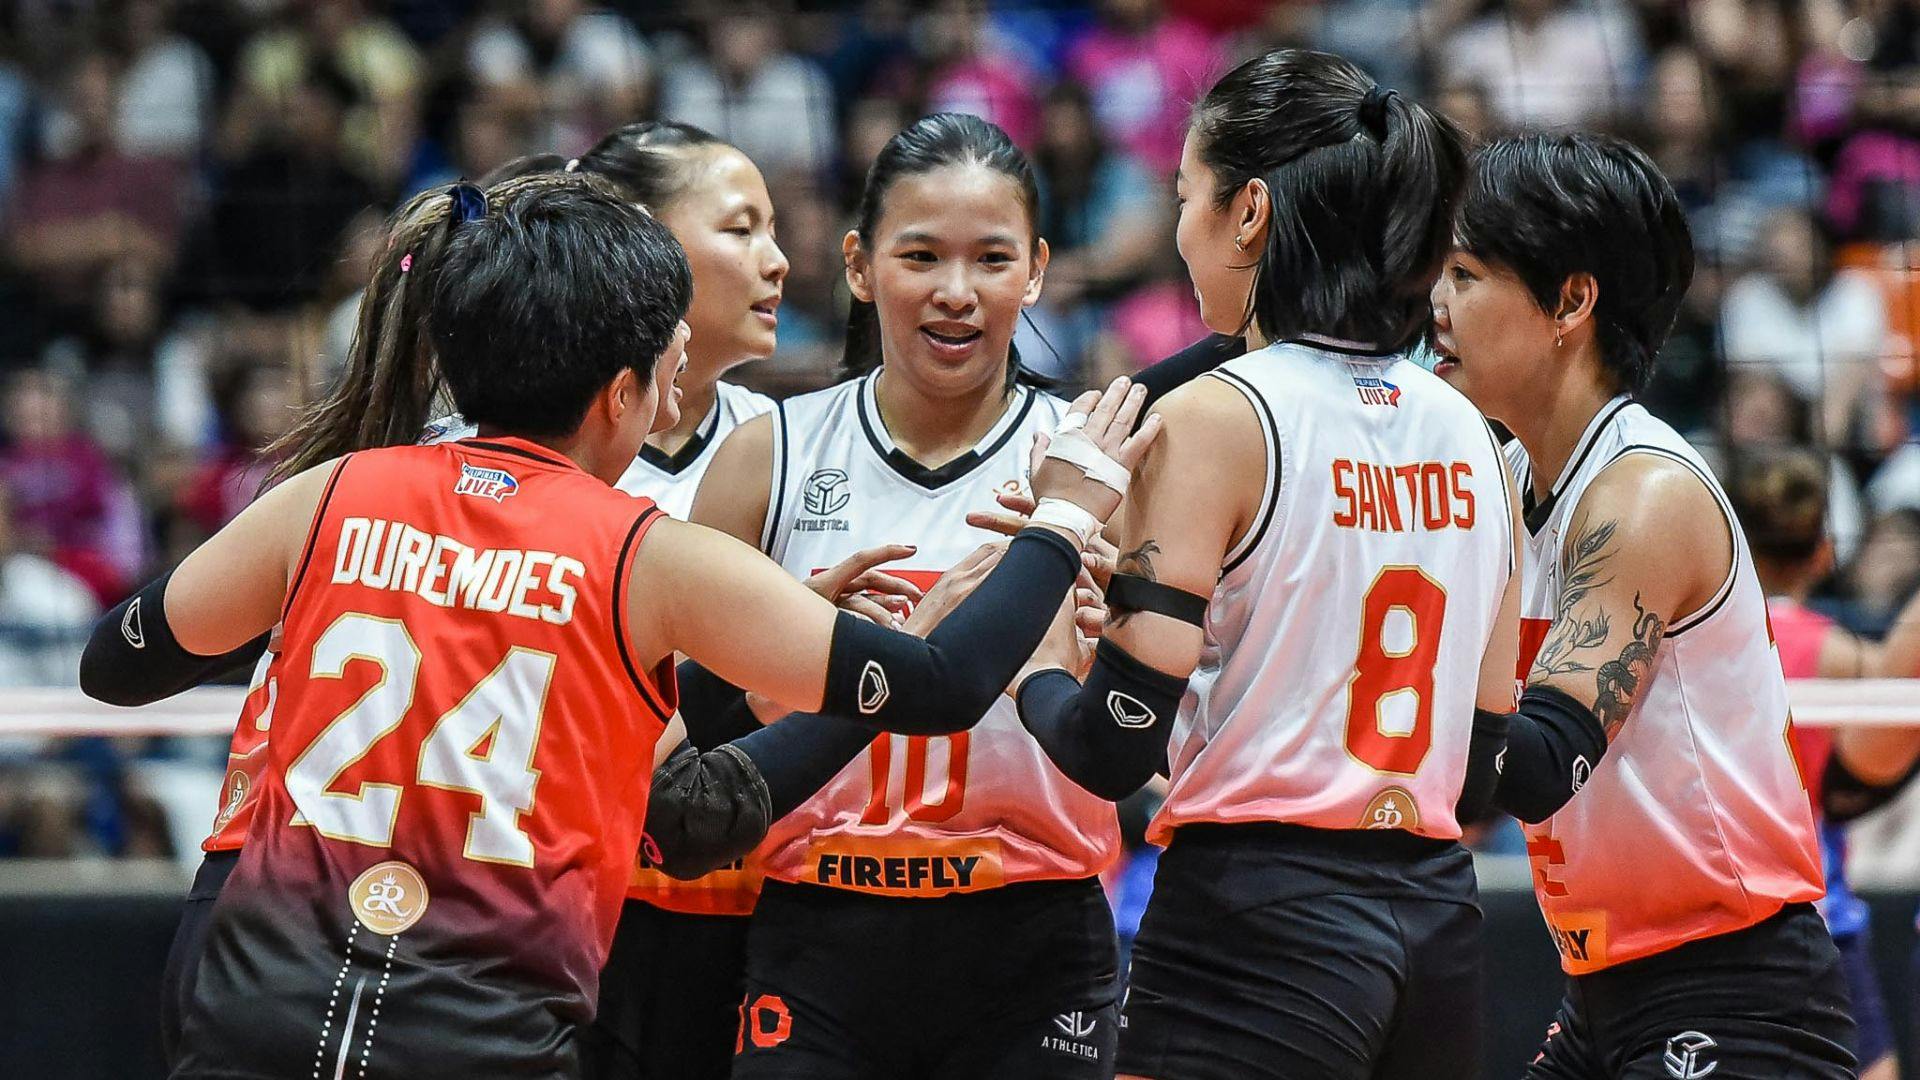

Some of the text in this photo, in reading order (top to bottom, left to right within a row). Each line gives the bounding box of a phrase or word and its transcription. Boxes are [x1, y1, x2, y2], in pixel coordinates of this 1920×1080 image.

[793, 518, 849, 532] ATHLETICA
[1332, 458, 1476, 532] SANTOS
[331, 516, 586, 626] DUREMDES
[1344, 563, 1447, 776] 8
[285, 612, 557, 868] 24
[858, 731, 972, 826] 10
[817, 854, 980, 889] FIREFLY
[1041, 1036, 1098, 1060] ATHLETICA
